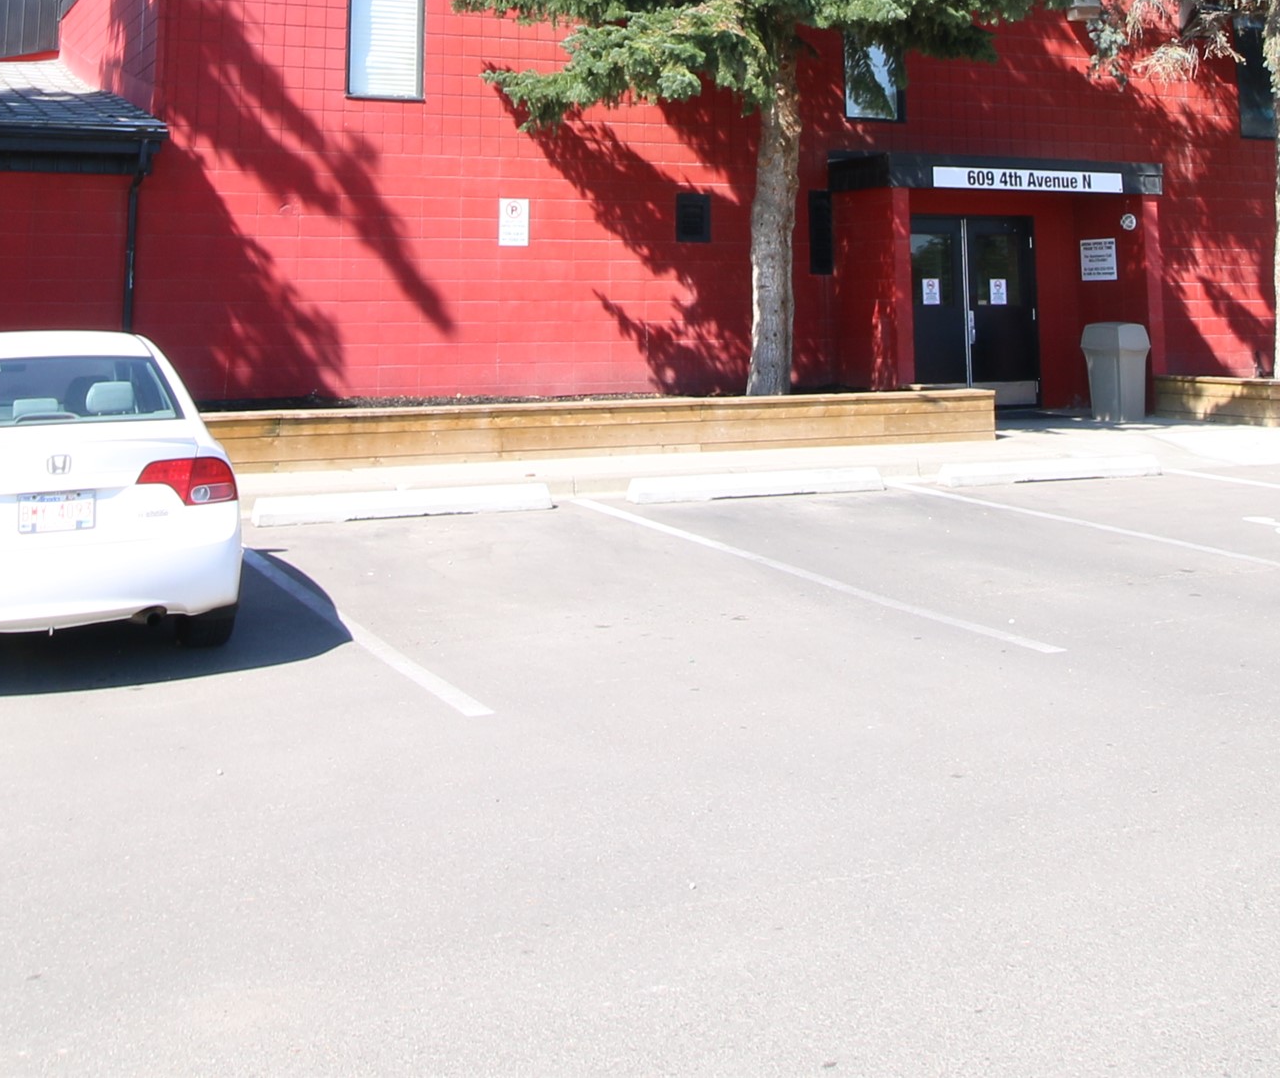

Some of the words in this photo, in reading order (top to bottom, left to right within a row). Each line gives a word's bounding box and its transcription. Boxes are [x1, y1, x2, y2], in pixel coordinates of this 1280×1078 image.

[967, 170, 995, 186] 609
[999, 171, 1022, 187] 4th
[1027, 172, 1078, 189] Avenue
[1082, 174, 1092, 189] N
